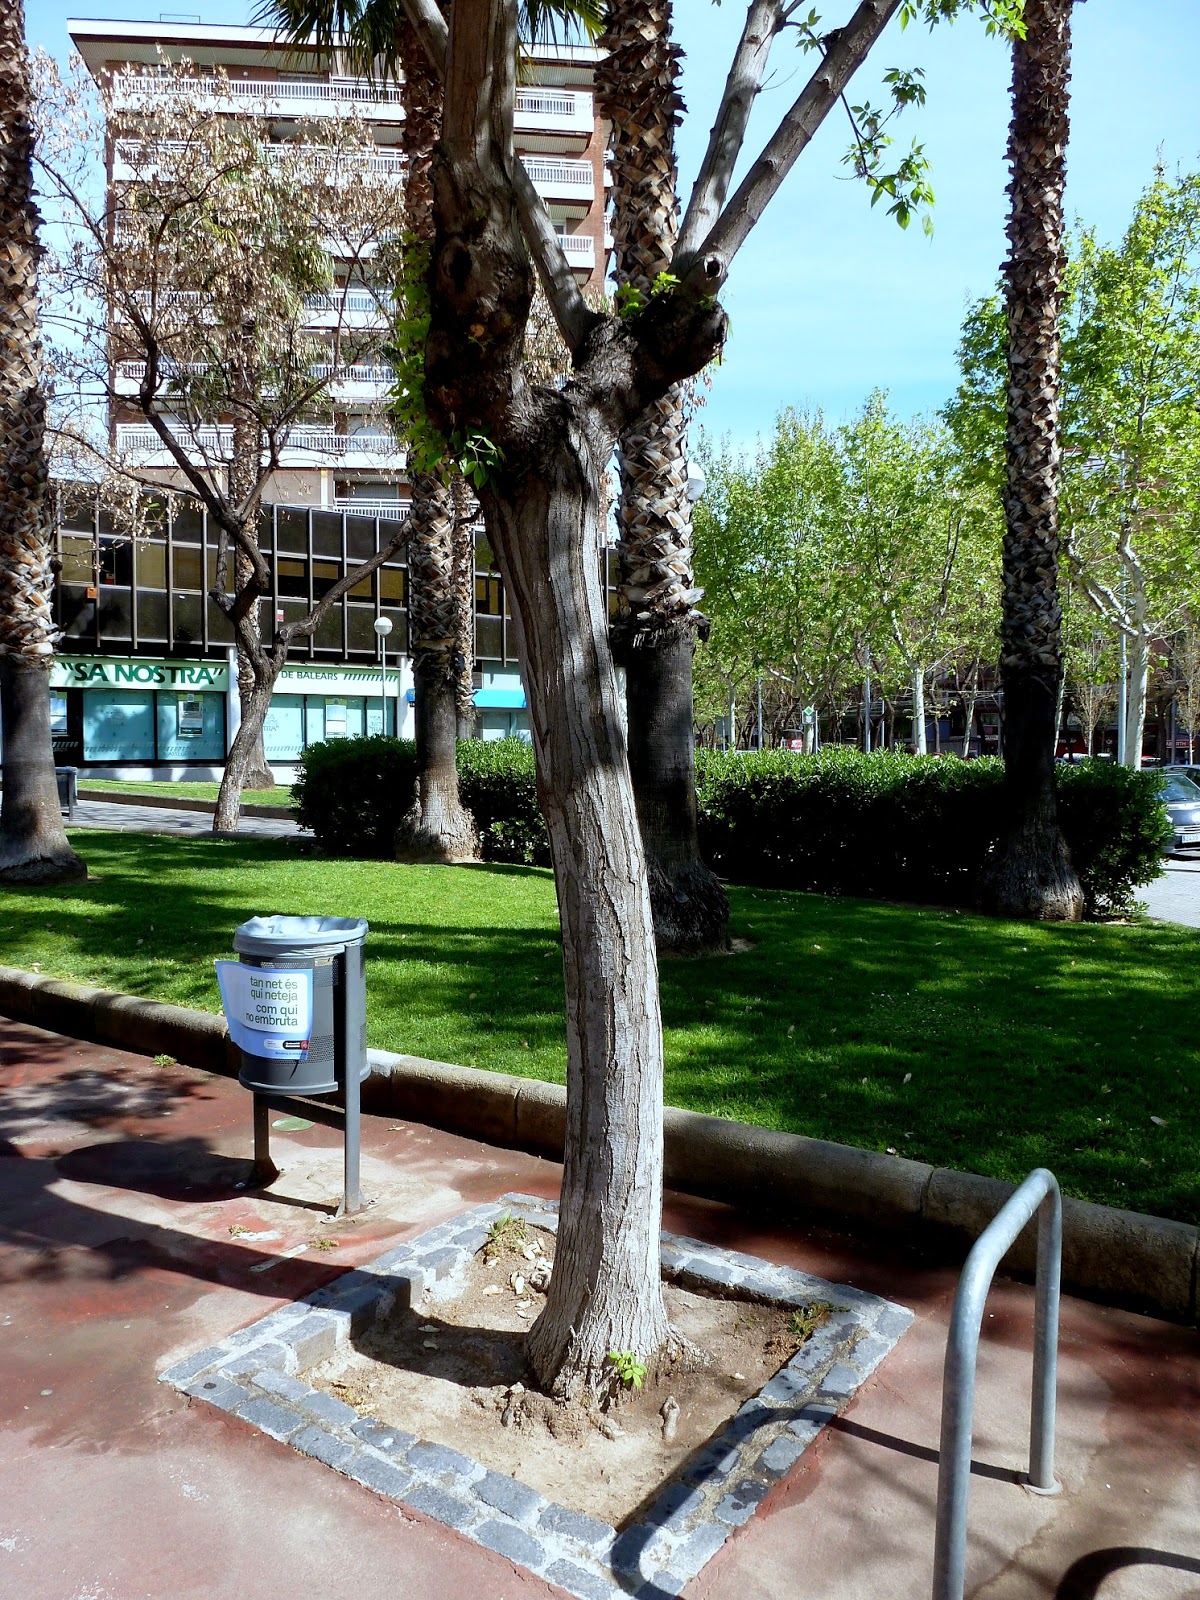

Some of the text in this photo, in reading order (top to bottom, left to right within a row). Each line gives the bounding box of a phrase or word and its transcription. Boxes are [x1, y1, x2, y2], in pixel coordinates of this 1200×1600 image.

[115, 664, 225, 684] NOSTRA"
[281, 670, 338, 680] DE BALEARS
[250, 976, 298, 989] tan net és
[250, 988, 298, 1003] qui neteja
[256, 1004, 298, 1018] com qui
[245, 1013, 298, 1026] no embruta
